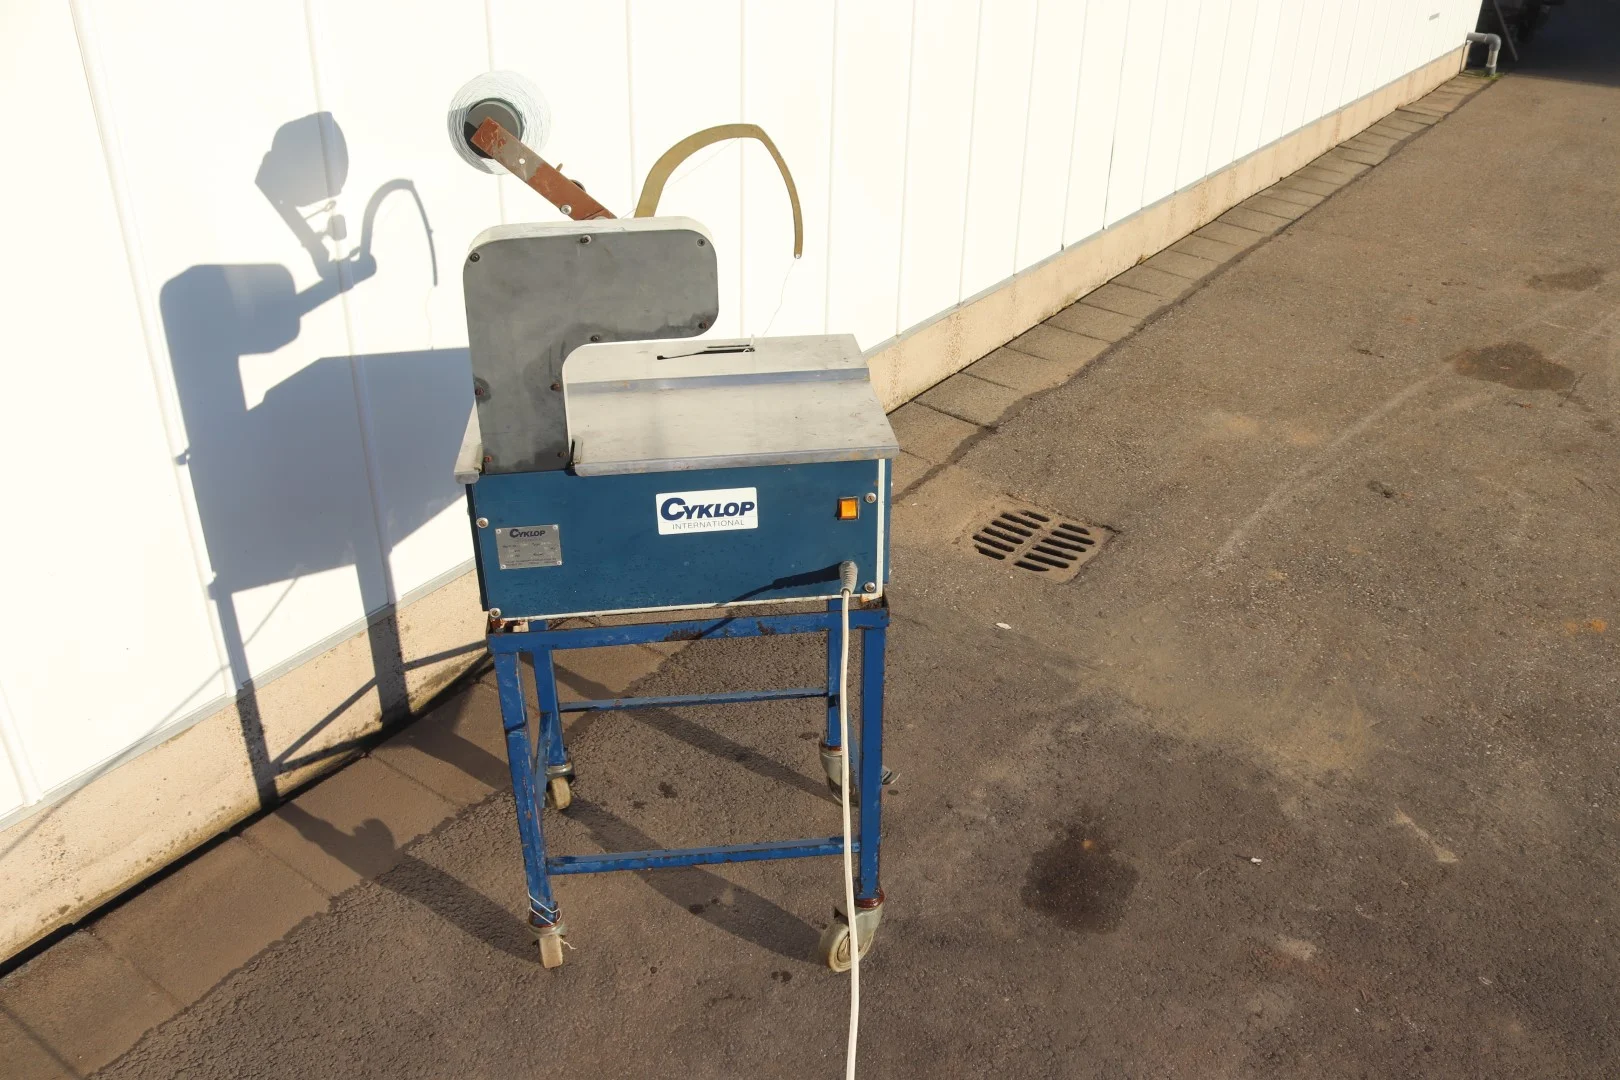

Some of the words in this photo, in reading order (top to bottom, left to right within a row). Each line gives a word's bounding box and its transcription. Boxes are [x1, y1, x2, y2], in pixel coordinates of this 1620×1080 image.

[660, 497, 755, 521] CYKLOP
[672, 519, 745, 530] INTERNATIONAL
[510, 528, 546, 538] CYKLOP
